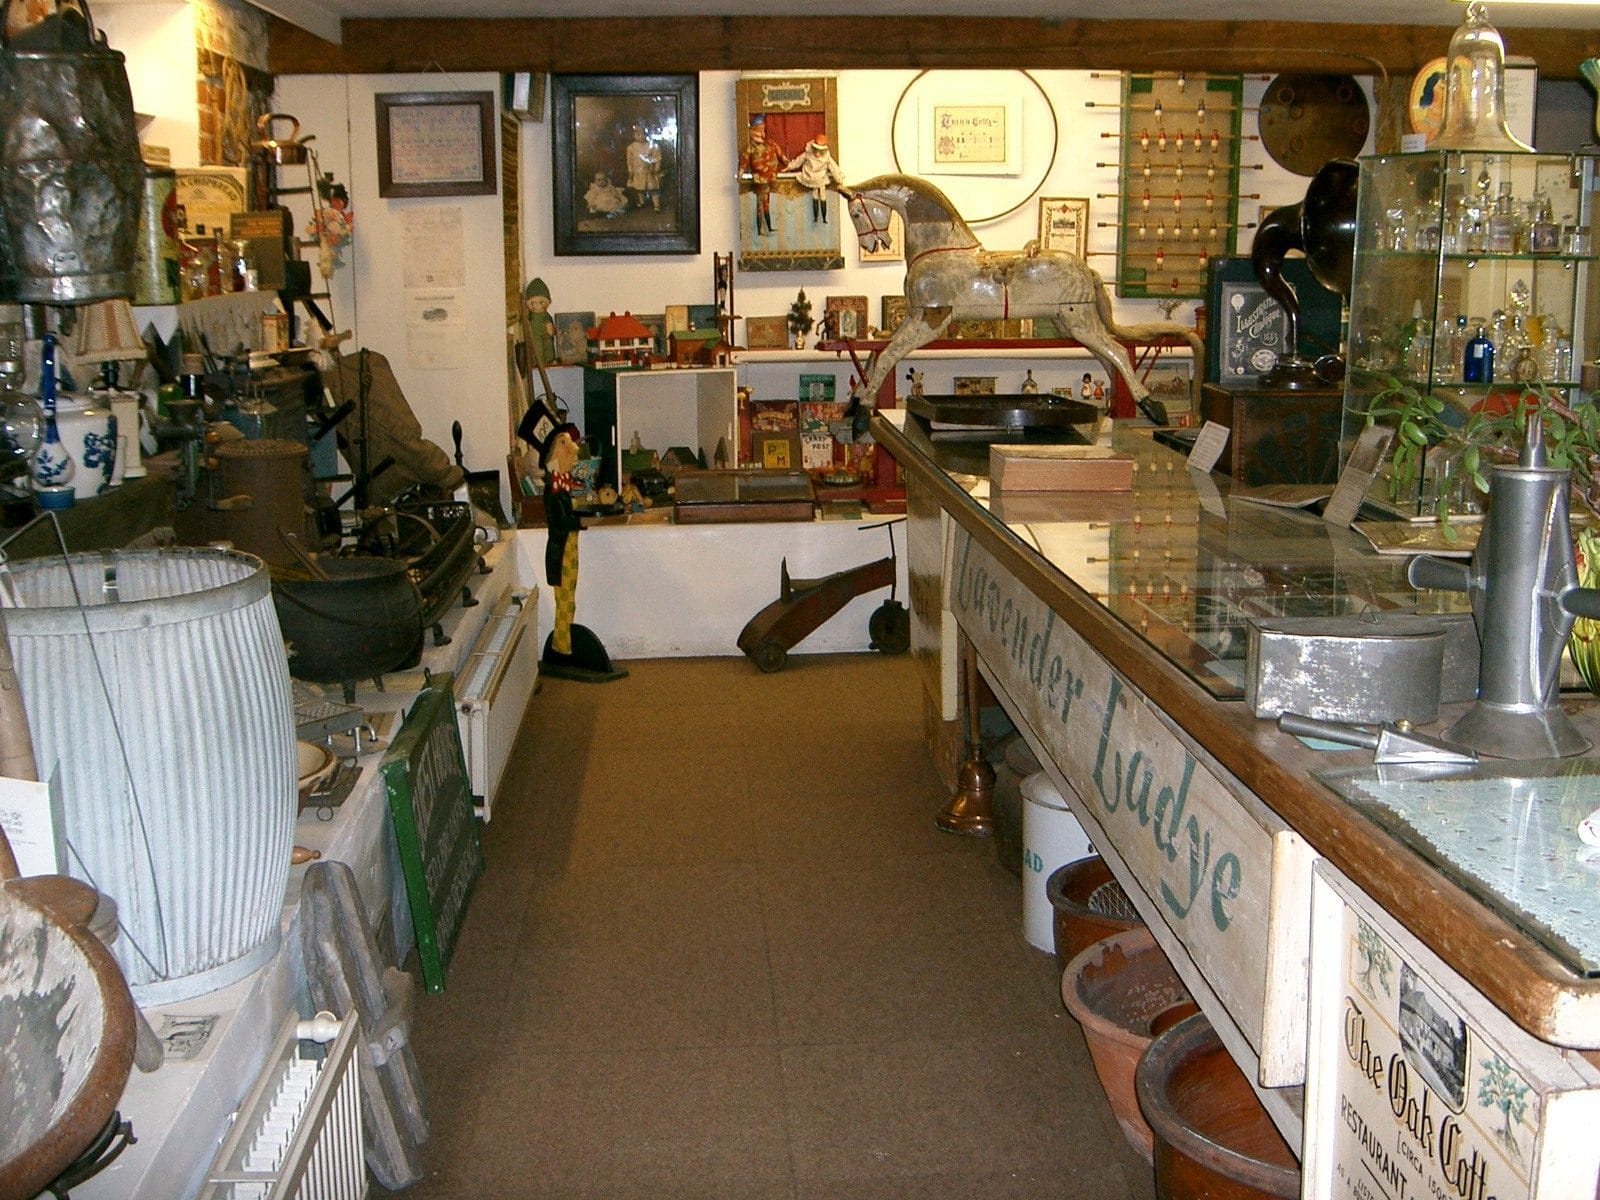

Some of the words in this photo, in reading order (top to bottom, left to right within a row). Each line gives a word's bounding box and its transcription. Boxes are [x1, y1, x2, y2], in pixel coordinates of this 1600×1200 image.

[957, 533, 1084, 724] Lavender
[1092, 675, 1242, 932] Ladye
[1341, 1094, 1408, 1199] RESTAURANT
[1345, 996, 1384, 1090] The
[1388, 1053, 1435, 1158] Oak
[1439, 1115, 1496, 1200] Cott
